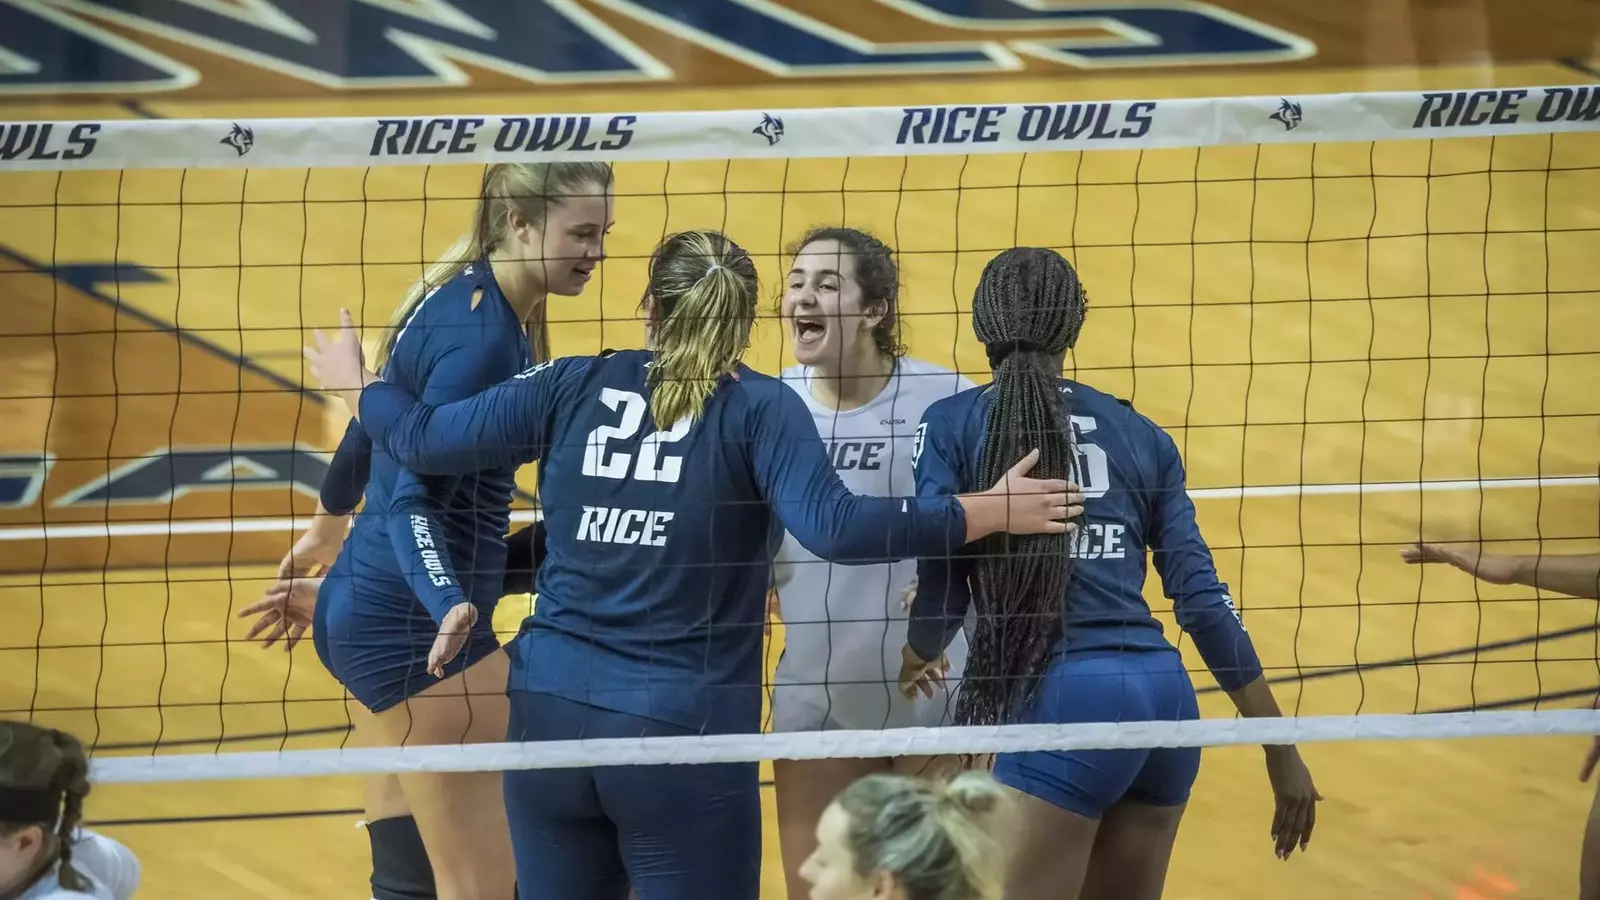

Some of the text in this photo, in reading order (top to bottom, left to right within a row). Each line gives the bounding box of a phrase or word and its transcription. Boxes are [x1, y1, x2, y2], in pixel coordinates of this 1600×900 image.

[896, 101, 1157, 144] RICE OWLS
[1412, 89, 1528, 128] RICE
[369, 115, 637, 156] RICE OWLS
[581, 387, 684, 482] 22
[823, 442, 886, 470] ICE
[576, 505, 674, 547] RICE
[1069, 523, 1126, 559] ICE
[410, 514, 452, 587] RICE OWLS
